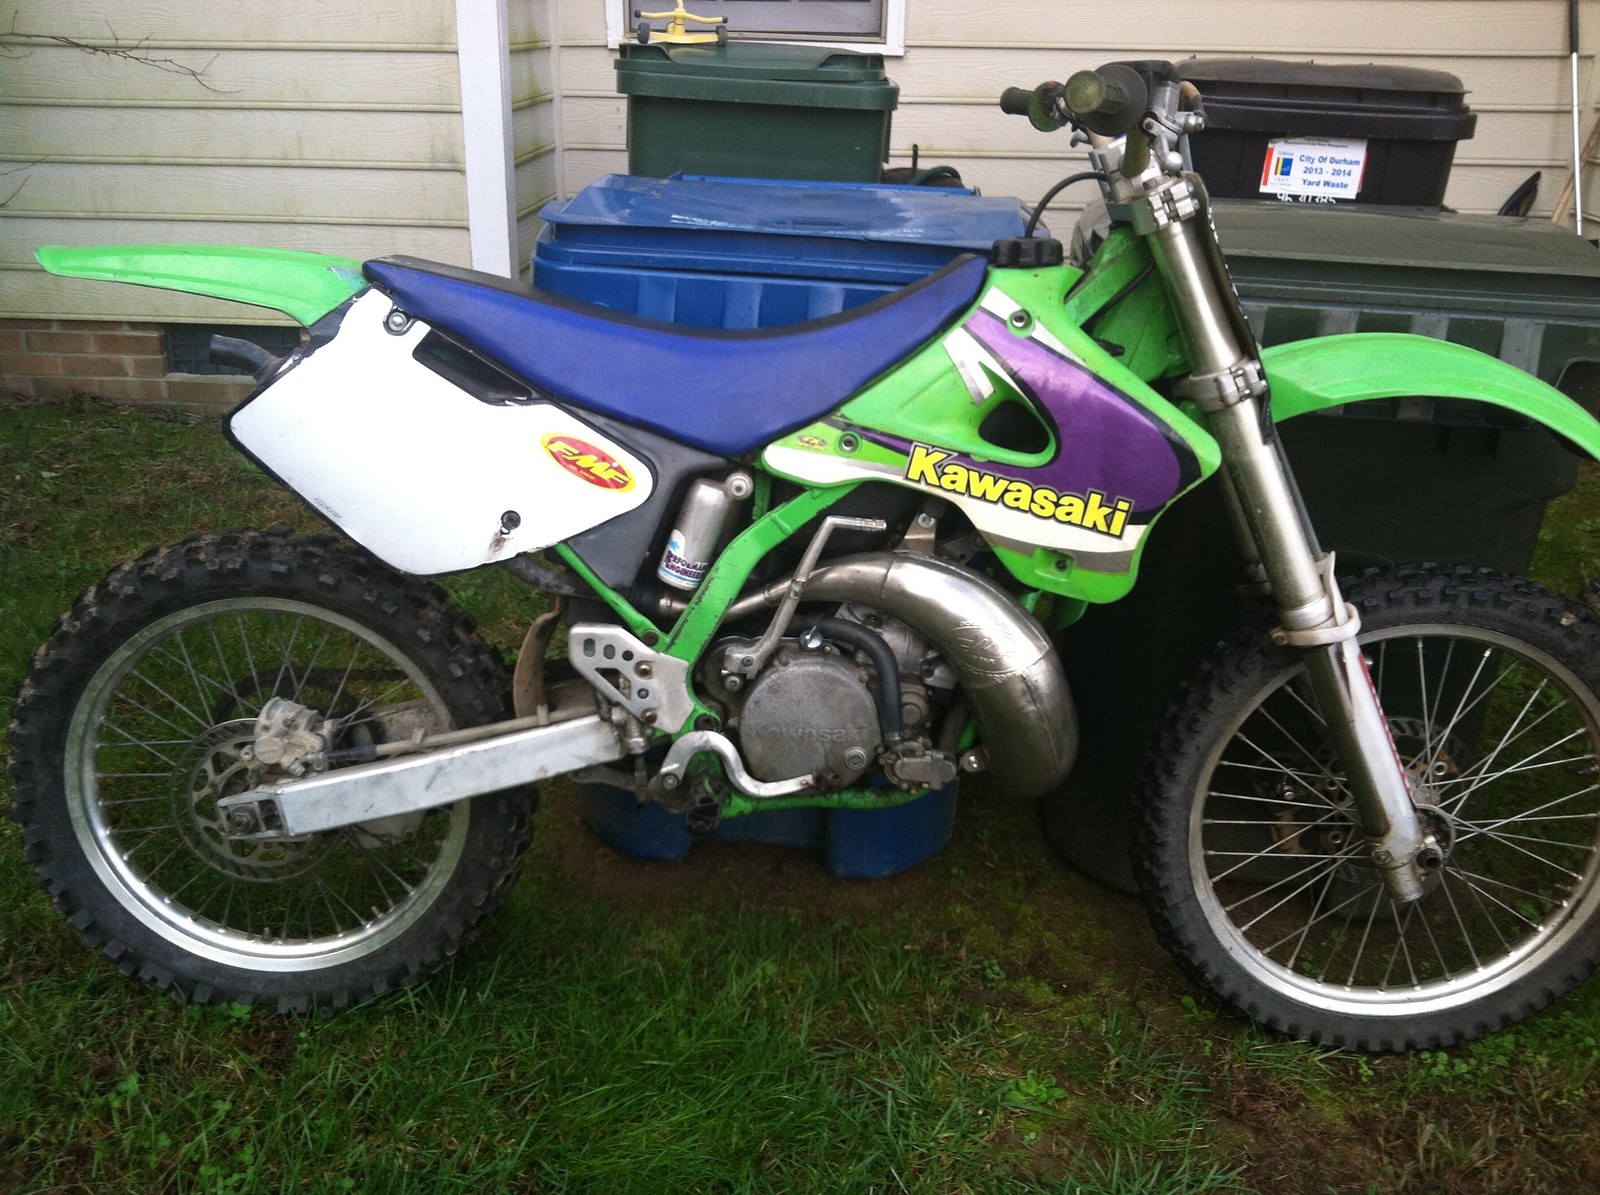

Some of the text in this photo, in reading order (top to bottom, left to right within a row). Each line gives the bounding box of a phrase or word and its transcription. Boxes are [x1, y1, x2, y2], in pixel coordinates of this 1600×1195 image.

[1299, 154, 1360, 166] City Of Durham
[1303, 166, 1323, 175] 2013
[1331, 168, 1352, 177] 2014
[1302, 178, 1320, 187] Yard
[1323, 179, 1349, 189] Waste
[544, 440, 632, 484] FMF
[906, 445, 1132, 538] Kawasaki
